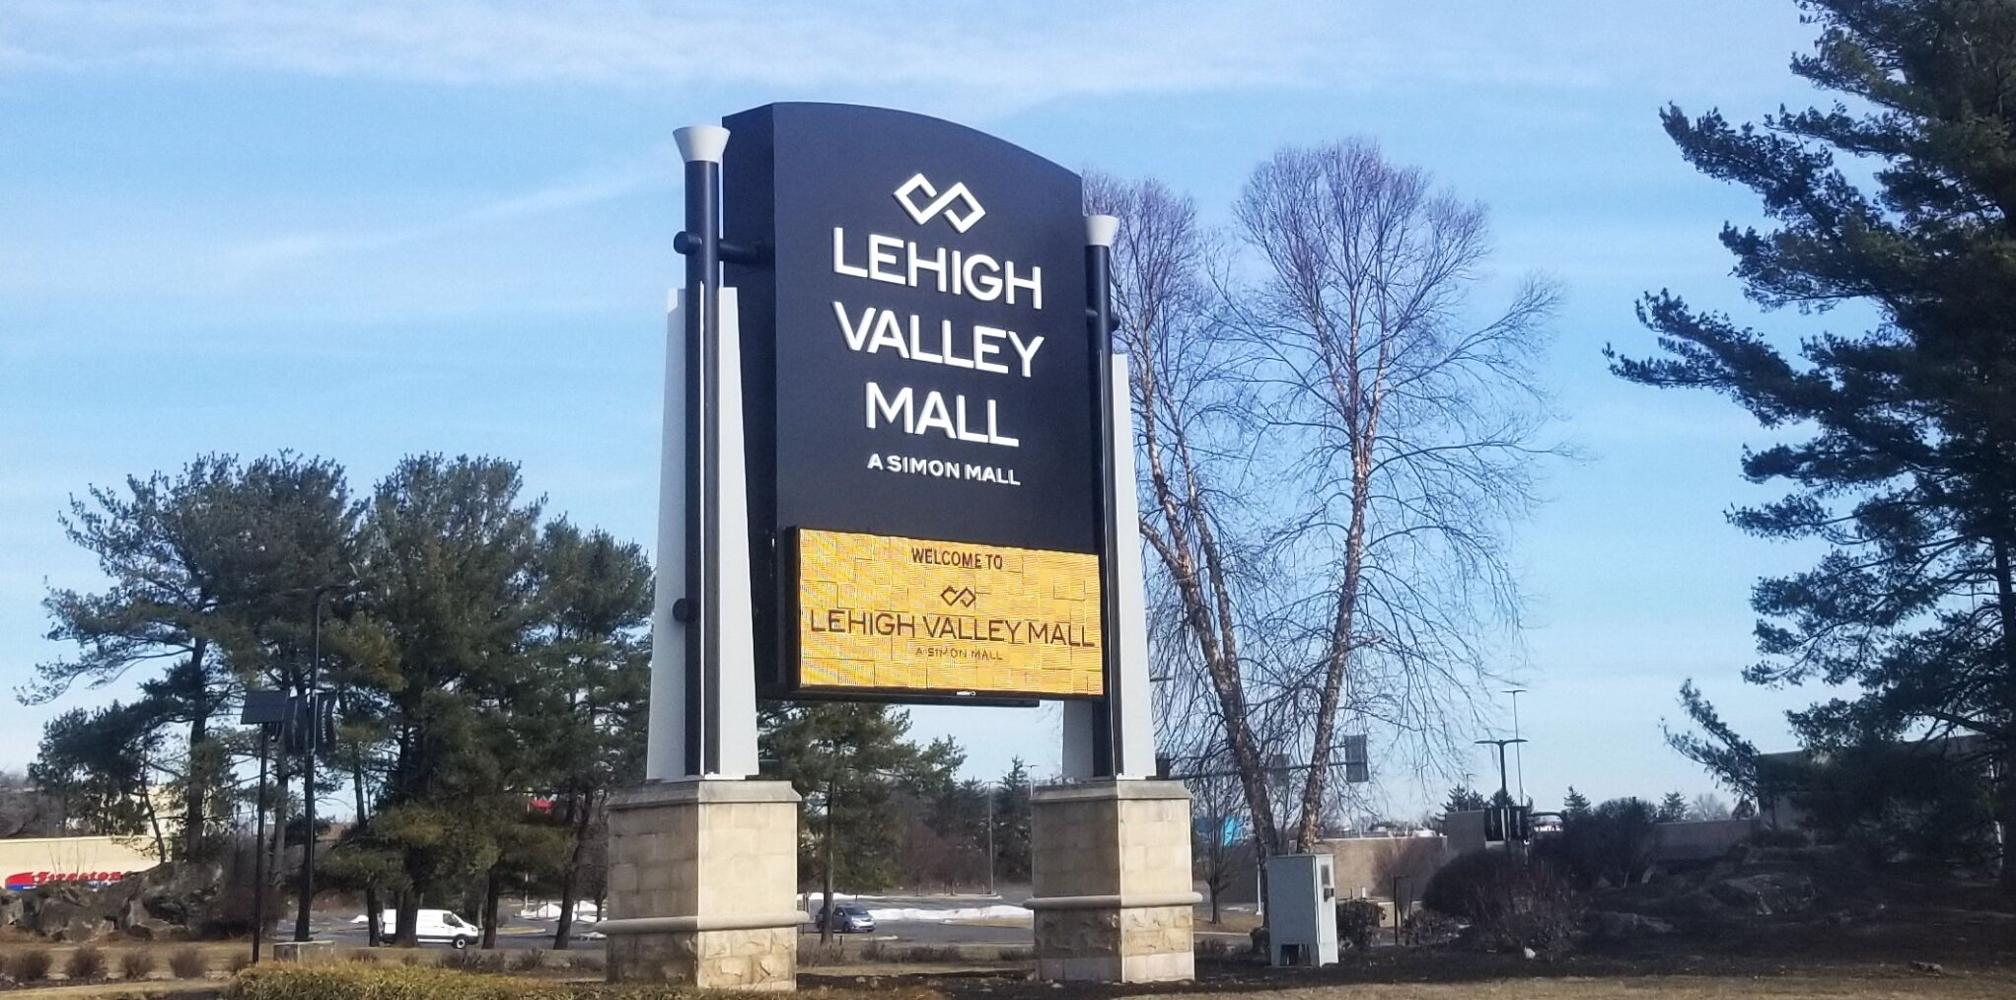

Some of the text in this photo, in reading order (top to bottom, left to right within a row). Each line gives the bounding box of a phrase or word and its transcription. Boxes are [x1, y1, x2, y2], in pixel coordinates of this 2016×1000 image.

[833, 227, 1042, 309] LEHIGH
[831, 301, 1045, 378] VALLEY
[866, 382, 1019, 447] MALL
[867, 453, 1021, 485] A SIMON MALL
[911, 547, 1003, 570] WELCOME TO
[811, 609, 1095, 647] LEHIGH VALLEY MALL
[916, 648, 1003, 661] A SIMON MALL
